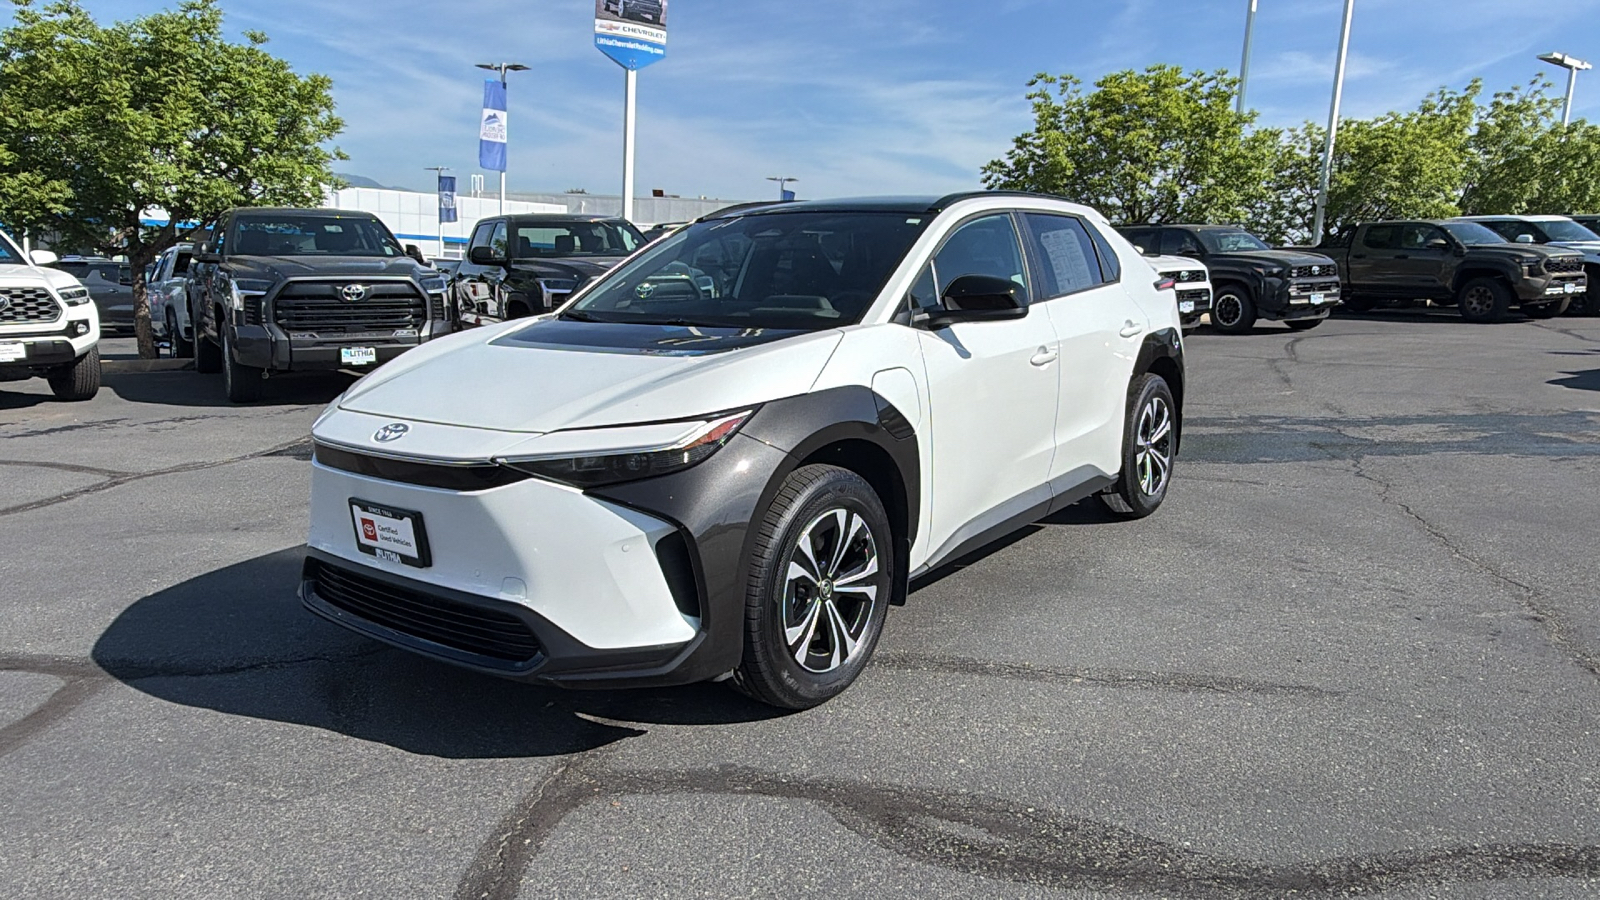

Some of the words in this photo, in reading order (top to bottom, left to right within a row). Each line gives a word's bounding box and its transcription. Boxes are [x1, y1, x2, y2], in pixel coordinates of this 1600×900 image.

[622, 26, 664, 38] CHEVROLET
[377, 525, 398, 535] Certified
[380, 534, 392, 543] Used
